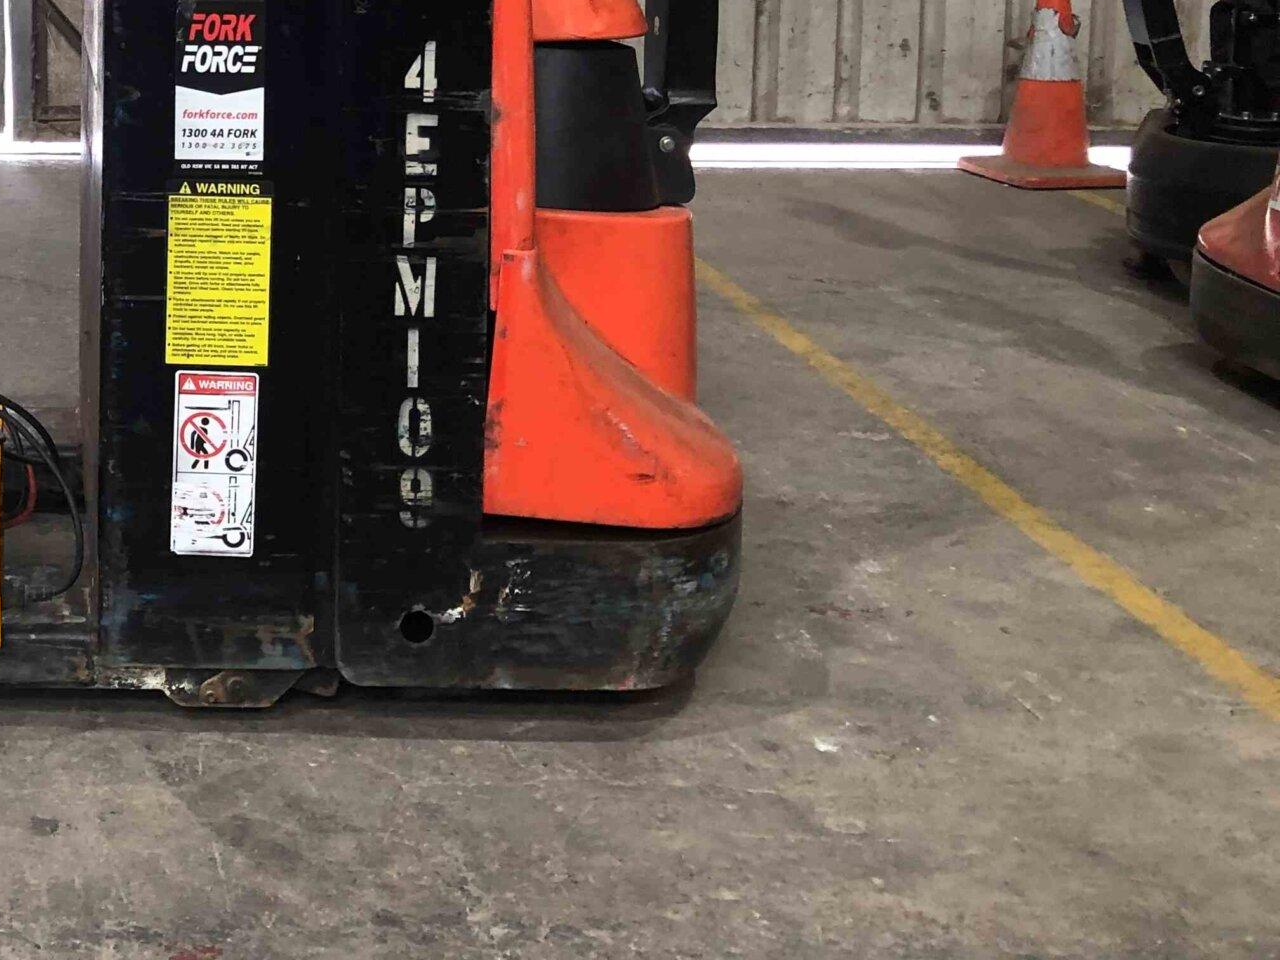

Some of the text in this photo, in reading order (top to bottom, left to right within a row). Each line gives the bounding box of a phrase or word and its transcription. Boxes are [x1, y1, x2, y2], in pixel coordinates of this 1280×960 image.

[188, 13, 256, 41] FORK
[181, 45, 260, 73] FORCE
[182, 109, 258, 120] forkforce.com
[181, 128, 258, 138] 1300 4A FORK
[196, 182, 260, 195] WARNING
[199, 379, 254, 391] WARNING
